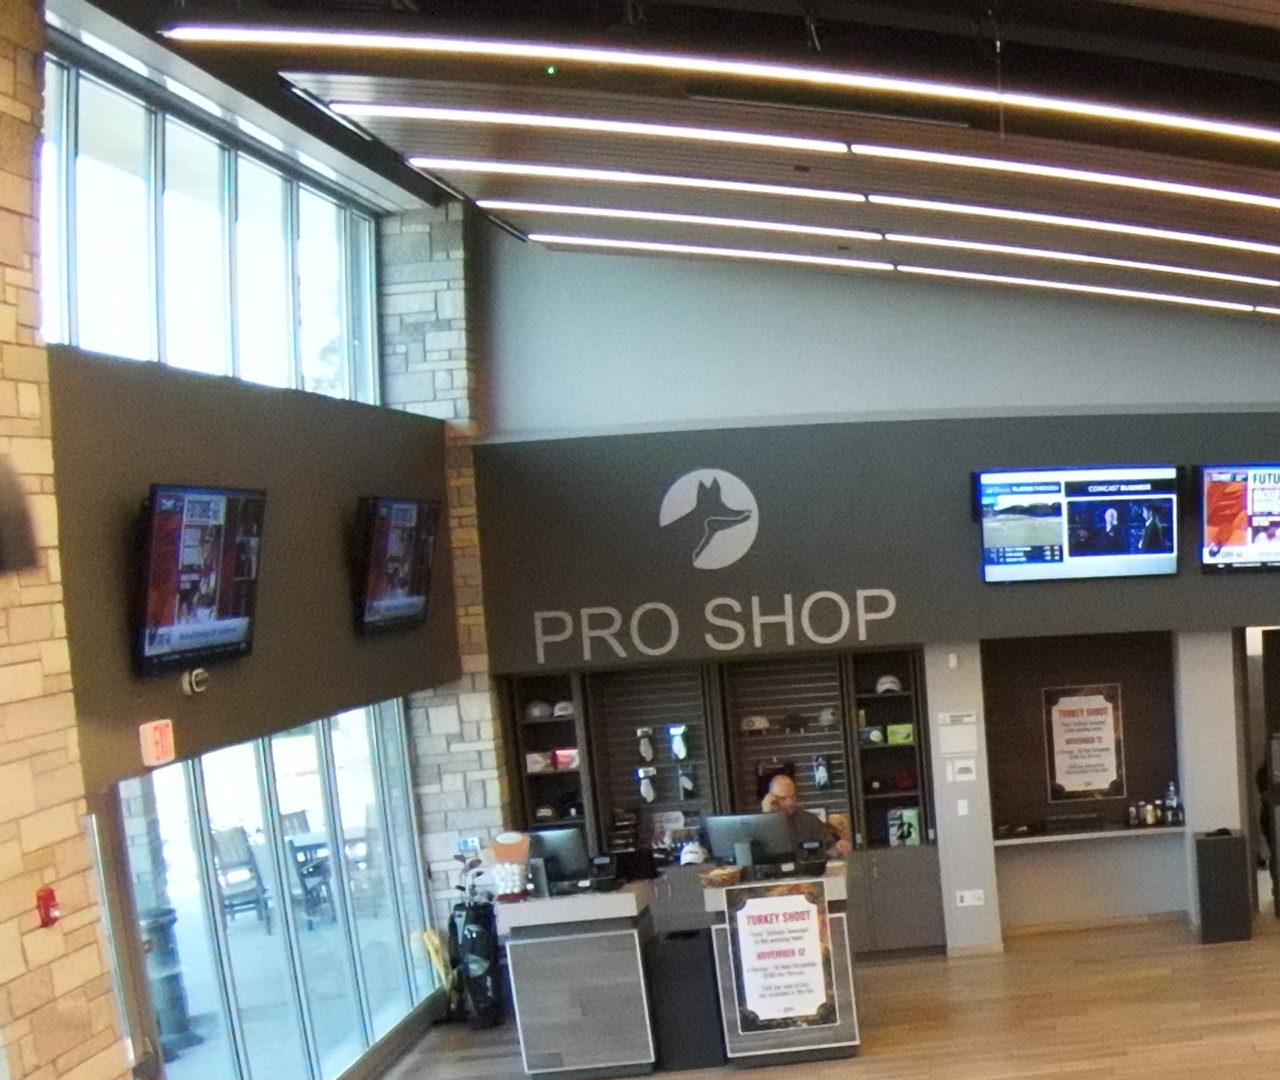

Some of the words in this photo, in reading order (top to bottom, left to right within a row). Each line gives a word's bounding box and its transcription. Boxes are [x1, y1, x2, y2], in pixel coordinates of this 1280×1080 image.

[534, 601, 680, 663] PRO
[704, 588, 896, 651] SHOP
[747, 913, 778, 925] TURKEY
[783, 910, 810, 922] SHOOT
[757, 949, 795, 960] NOVEMBER
